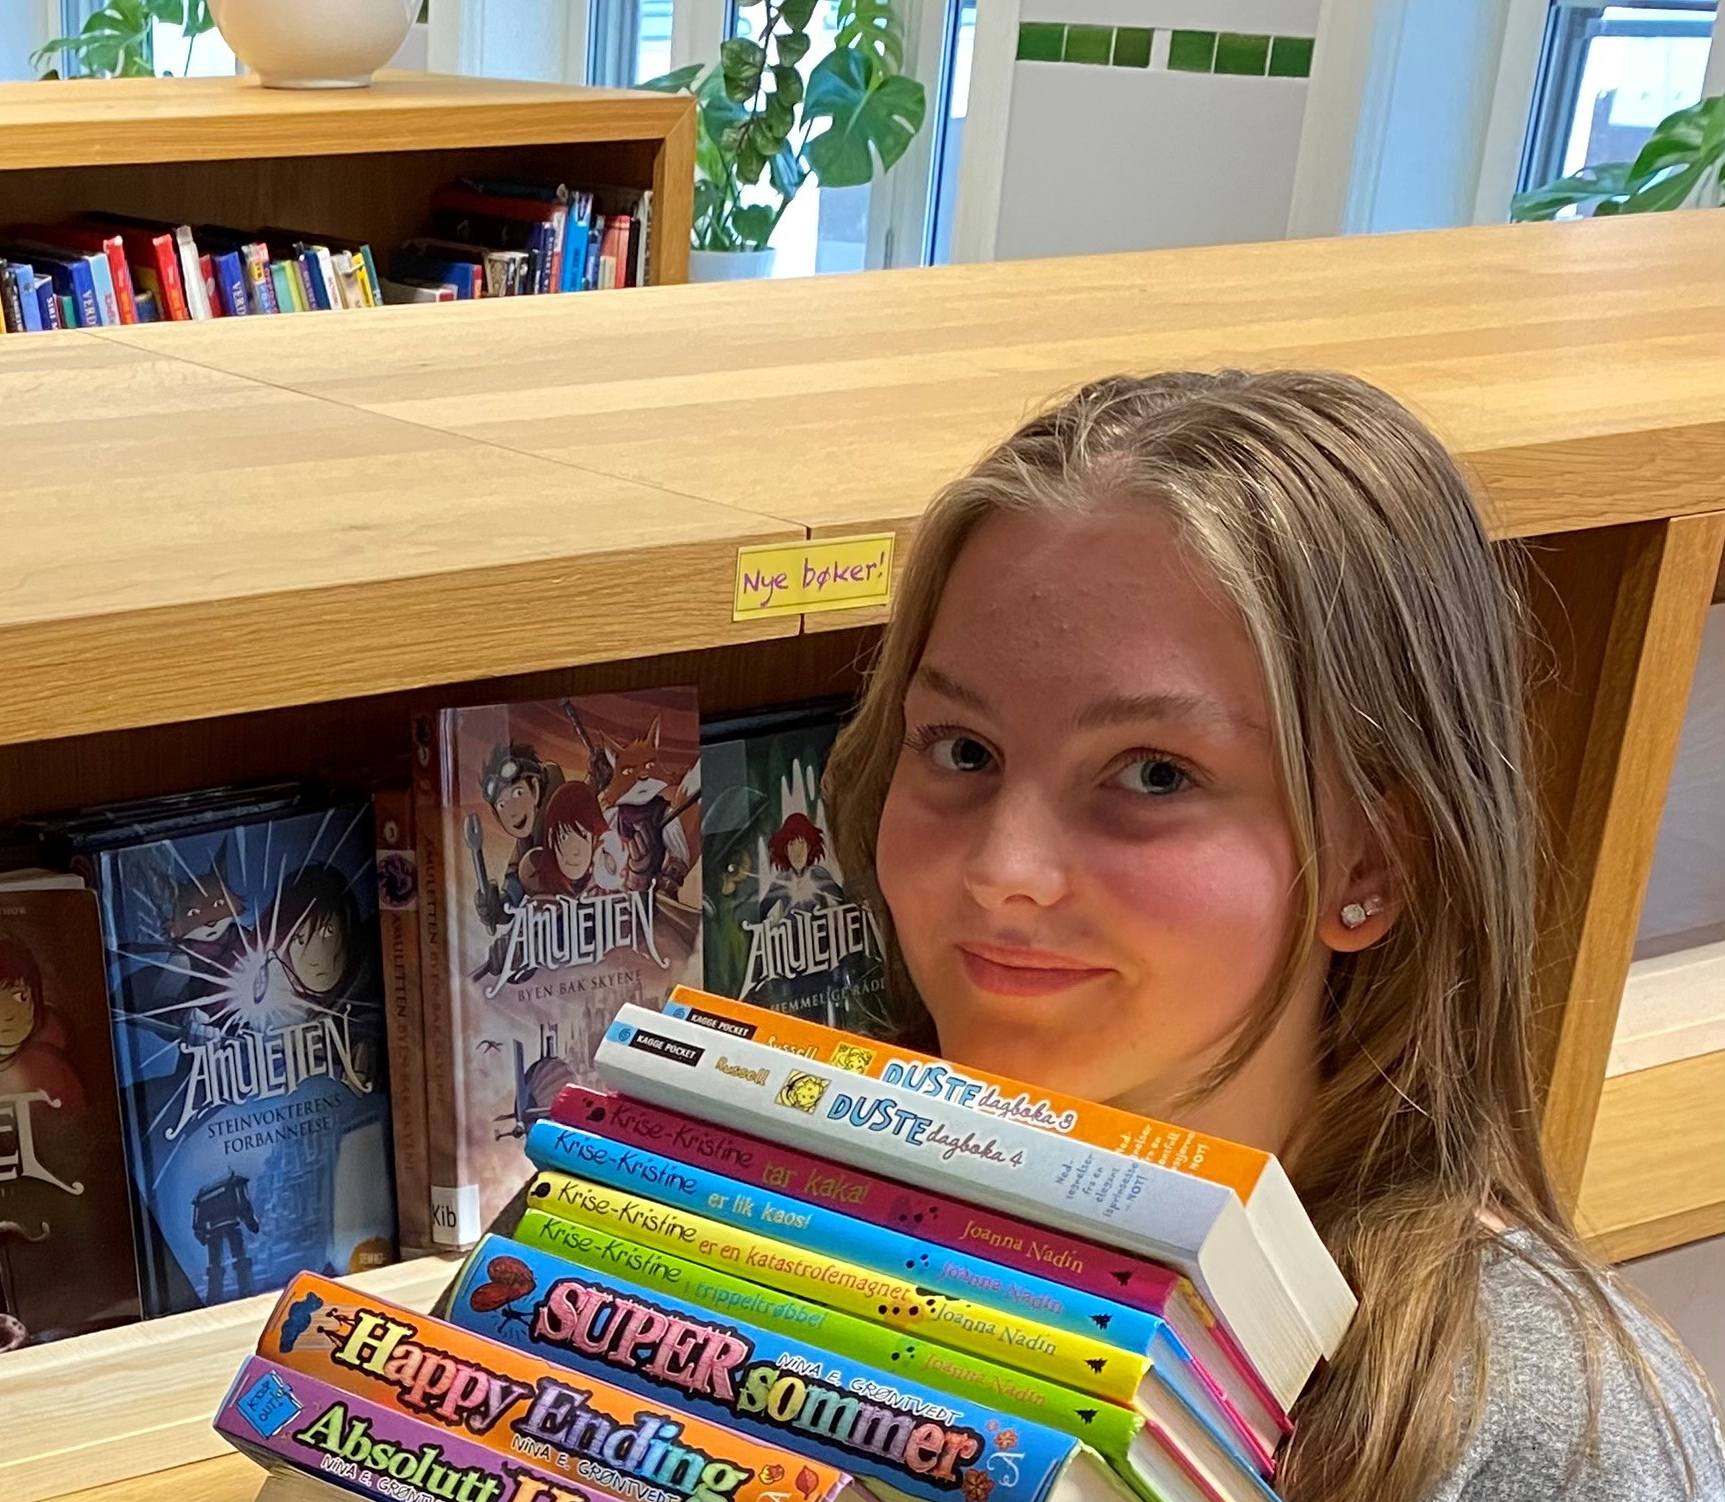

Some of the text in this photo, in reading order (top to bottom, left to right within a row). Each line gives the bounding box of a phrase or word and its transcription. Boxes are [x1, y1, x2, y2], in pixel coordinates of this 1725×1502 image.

[743, 551, 885, 607] Nye bøker!
[517, 968, 642, 1003] BYEN BAK SKYENE
[636, 1032, 699, 1060] KAGGE POCKET
[690, 1011, 751, 1038] KAGGE POCKET
[715, 1056, 772, 1087] Russell
[207, 1094, 342, 1141] STEINVOKTERENS
[223, 1115, 332, 1155] FORBANNELSE
[554, 1122, 812, 1229] Krise-Kristine er lik kaos!
[609, 1104, 869, 1206] Krise-Kristine tar kaka!
[1008, 1150, 1024, 1167] 4
[557, 1181, 912, 1302] Krise-Kristine er en katastrofemagnet
[958, 1220, 1084, 1274] Joanna Nadin
[539, 1218, 829, 1331] Krise-Kristine trippeltrøbbel
[534, 1280, 748, 1402] SUPER
[932, 1303, 1057, 1357] Joanna Nadin
[335, 1311, 527, 1428] Happy
[924, 1353, 1046, 1407] Joanna Nadin
[850, 1377, 963, 1426] GRØNTVEDT
